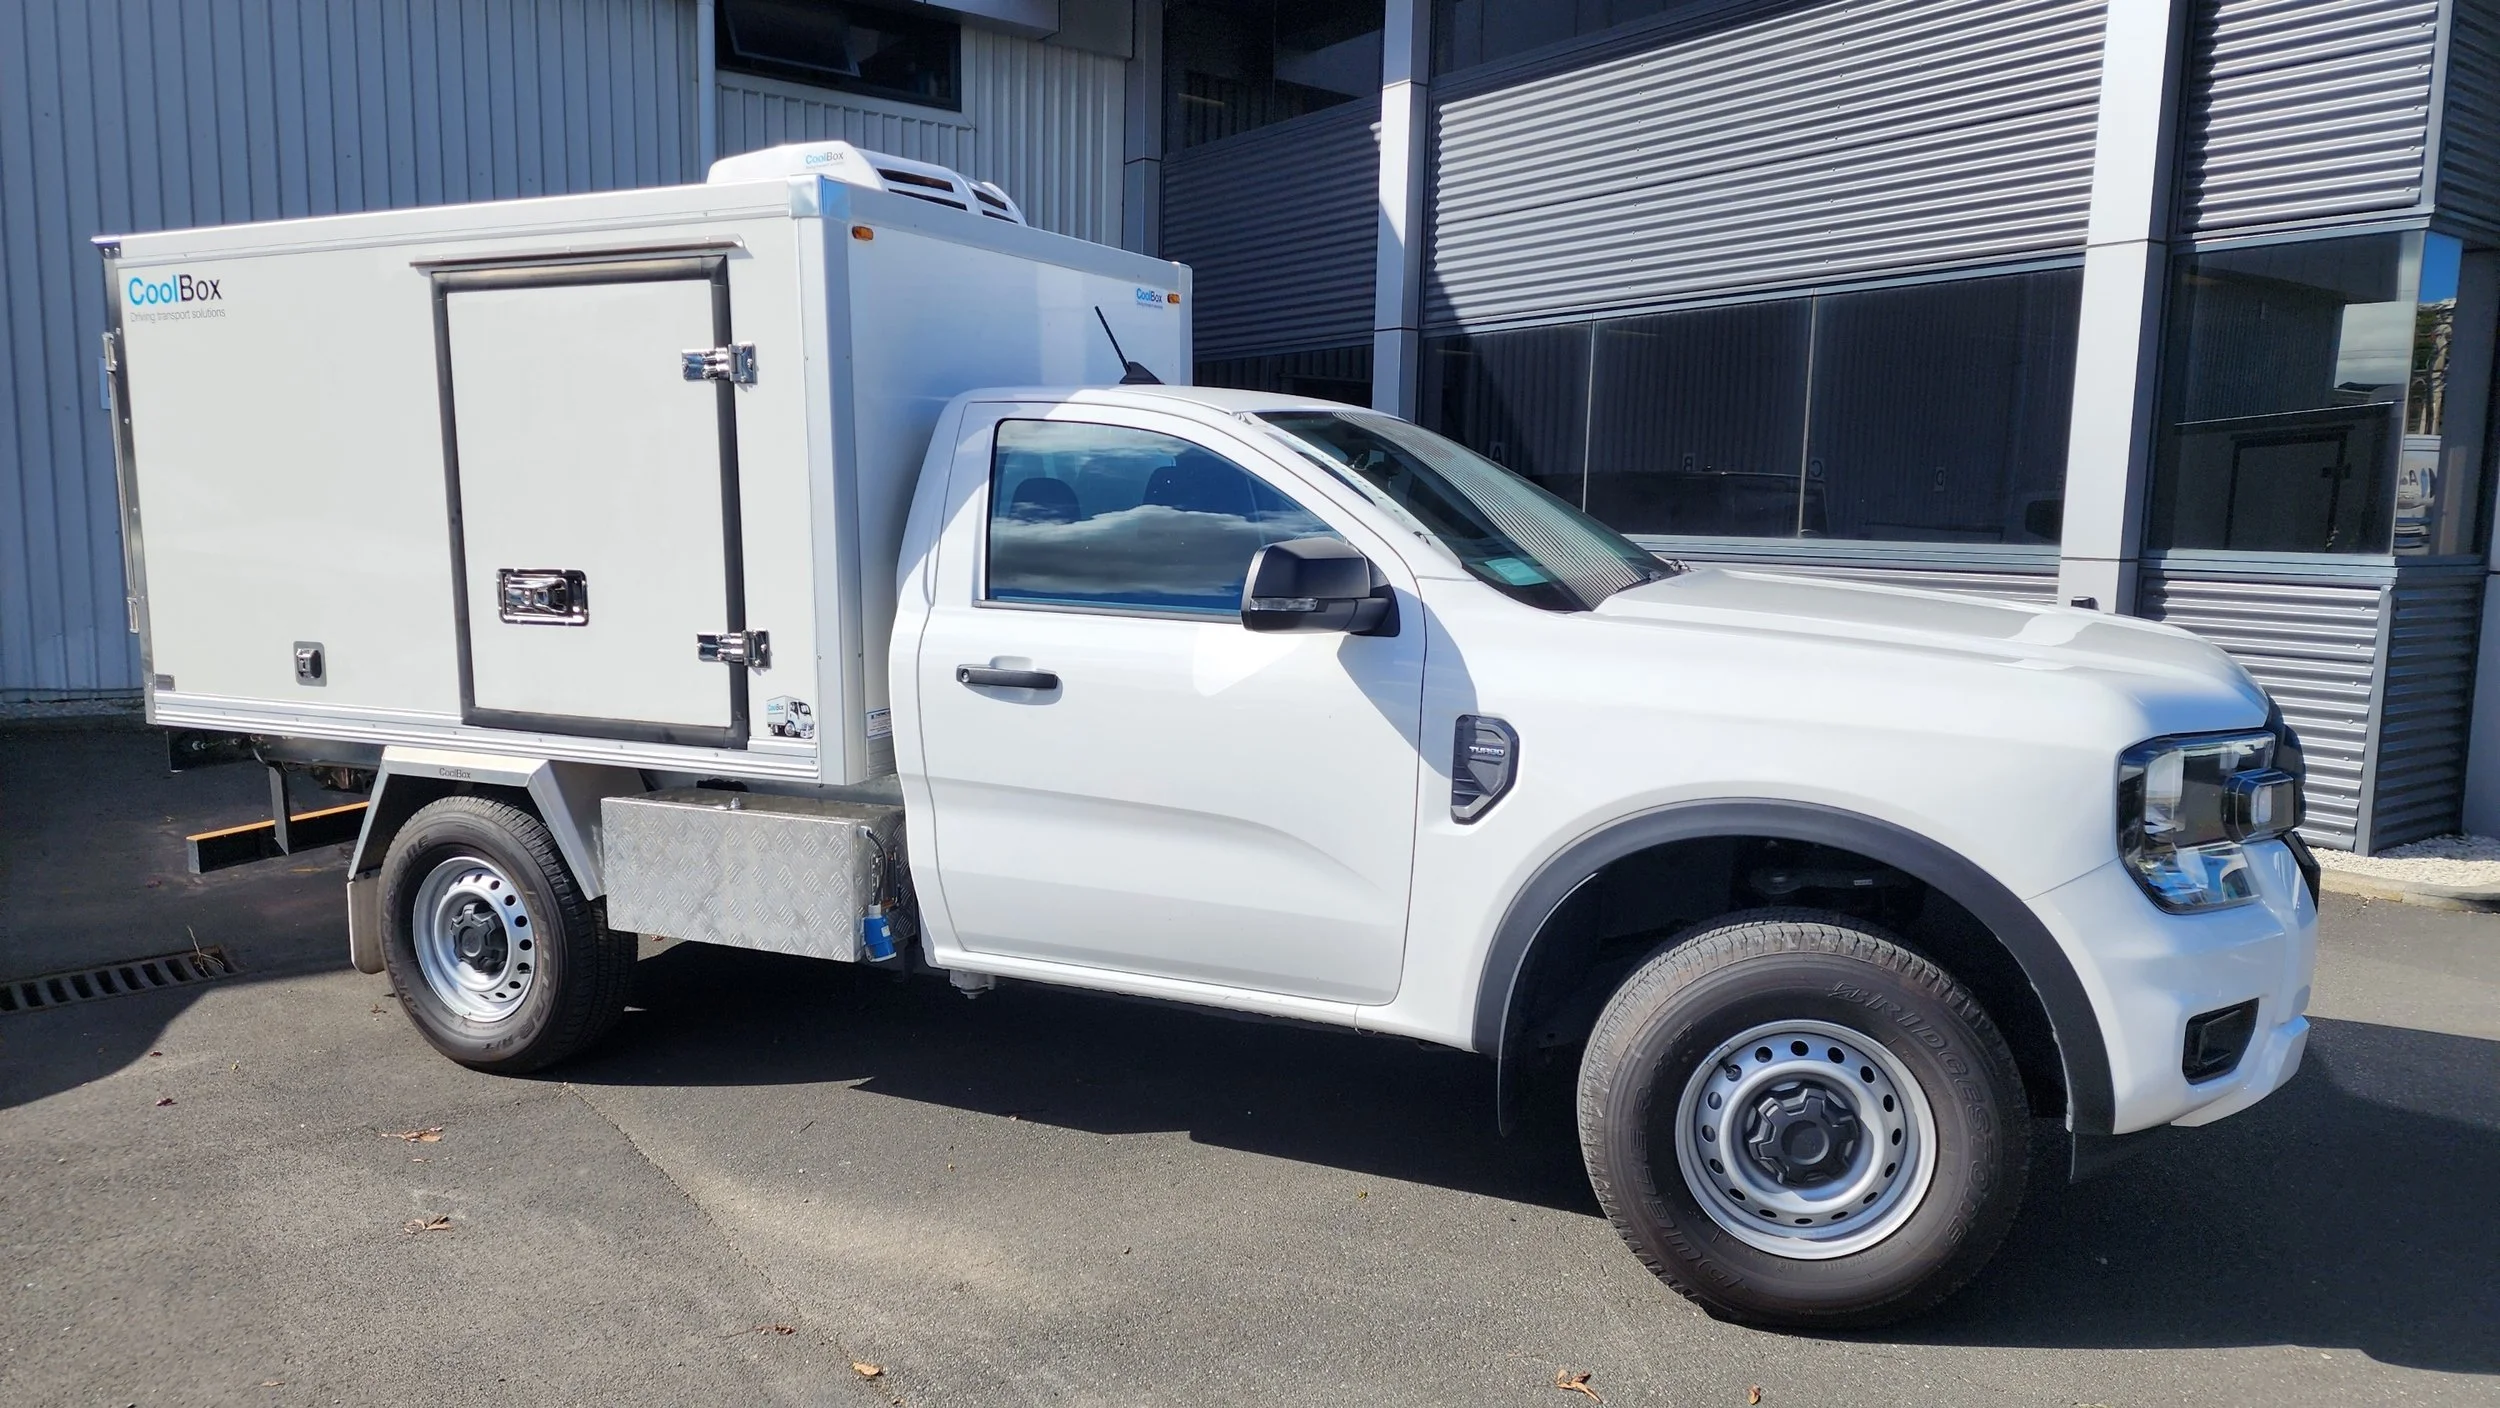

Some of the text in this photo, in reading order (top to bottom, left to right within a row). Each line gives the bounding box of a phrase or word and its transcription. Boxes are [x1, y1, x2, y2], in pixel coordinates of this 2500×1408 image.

[806, 152, 844, 164] CoolBox
[128, 274, 222, 305] CoolBox
[1136, 288, 1163, 303] CoolBox
[130, 308, 226, 323] Driving transport solutions
[1468, 745, 1505, 757] TURBO
[439, 767, 471, 780] CoolBox
